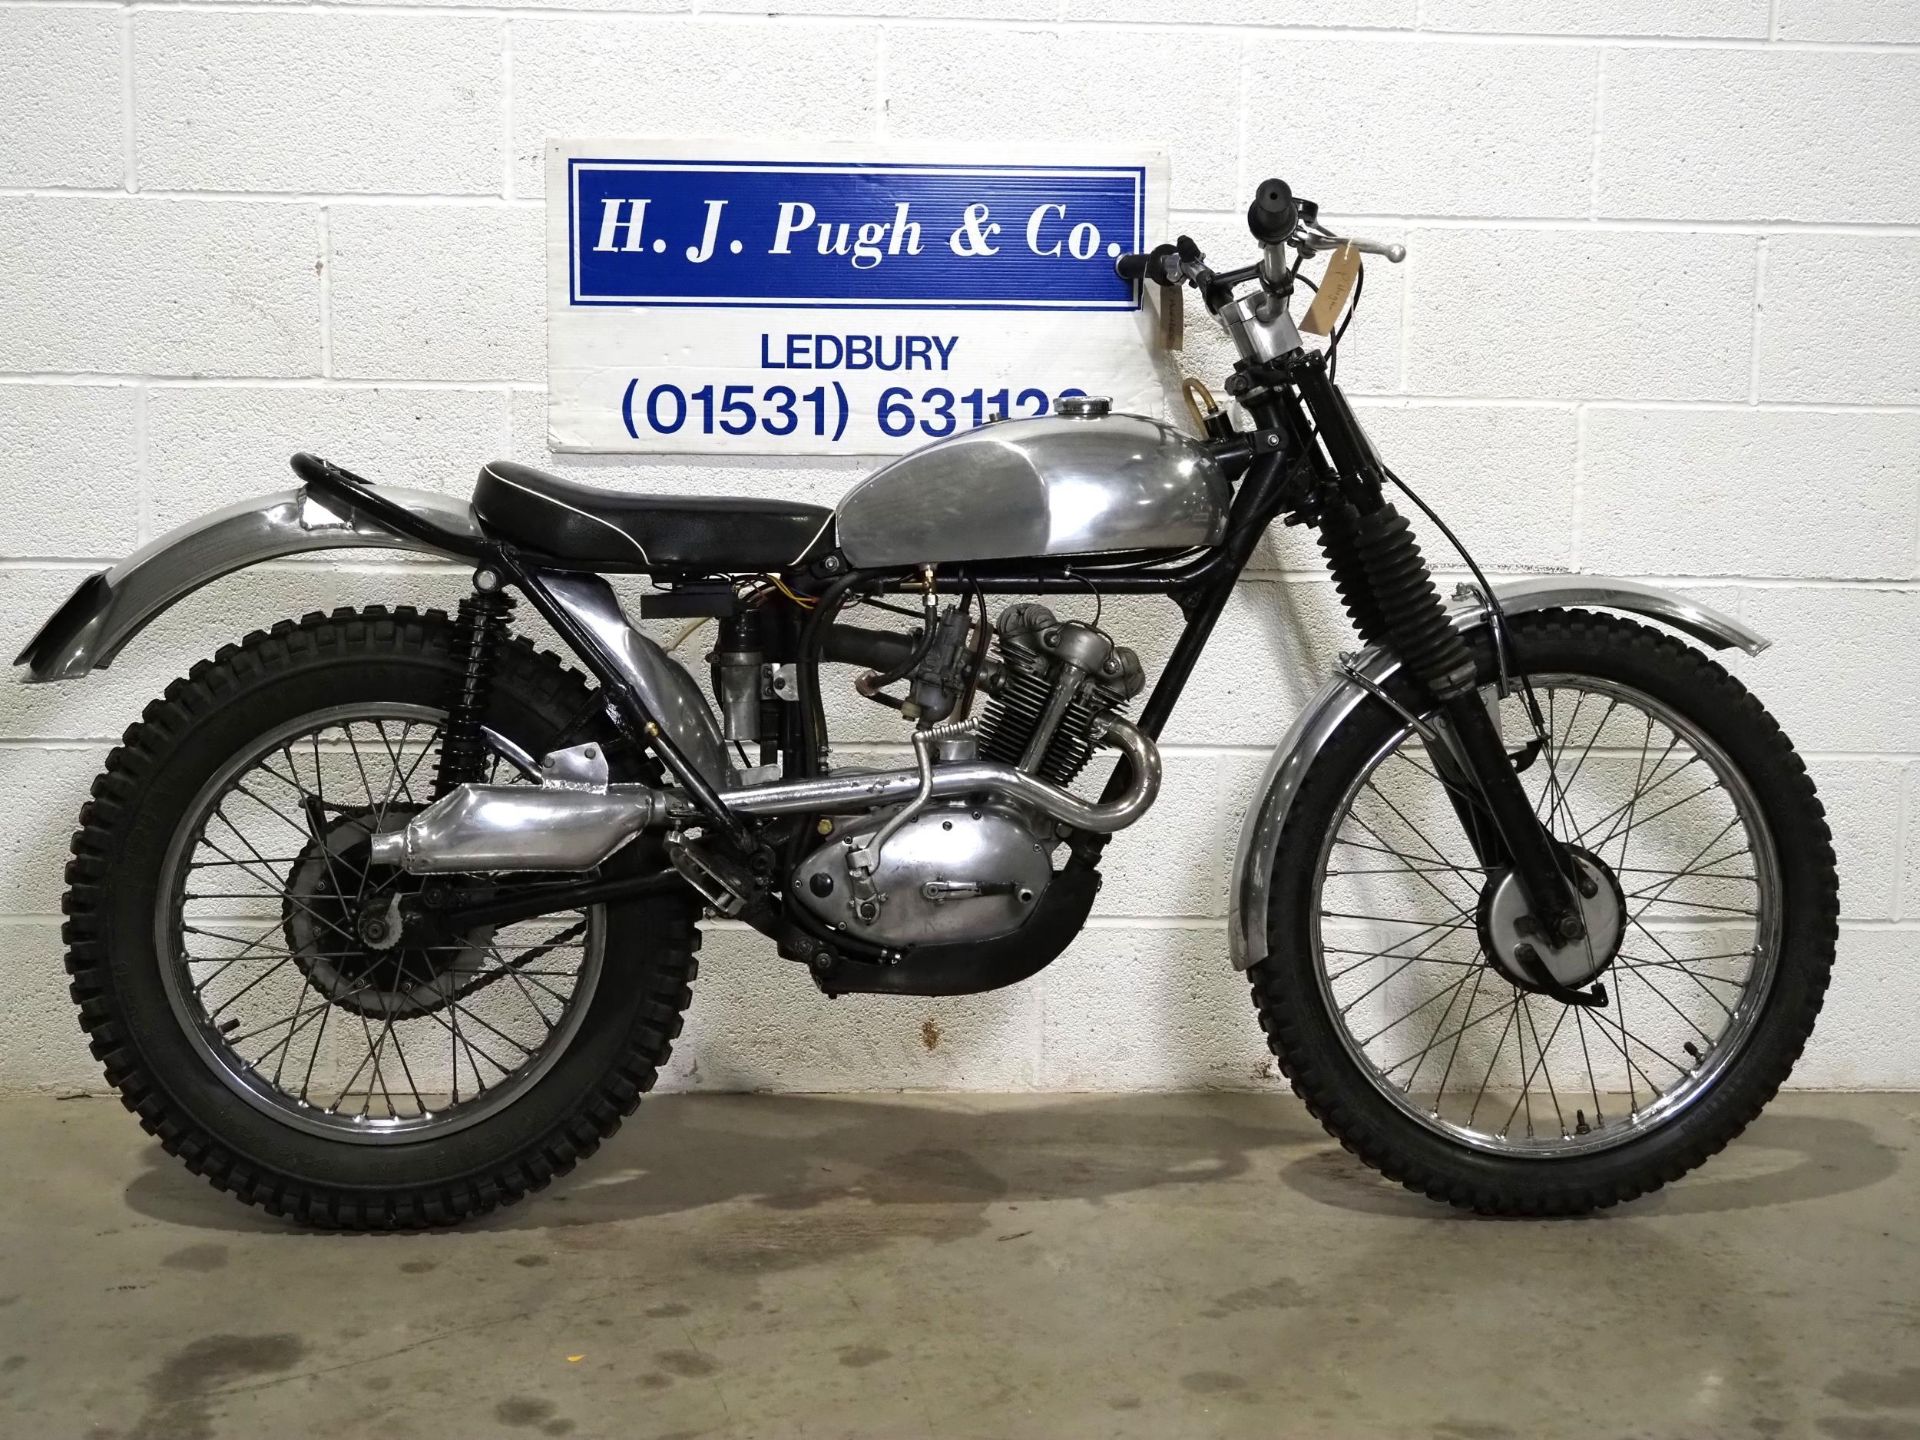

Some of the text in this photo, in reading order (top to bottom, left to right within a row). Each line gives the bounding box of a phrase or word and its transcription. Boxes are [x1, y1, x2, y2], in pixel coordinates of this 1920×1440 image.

[592, 198, 1121, 270] H. J. Pugh & Co.
[761, 334, 959, 371] LEDBURY
[622, 378, 1086, 441] (01531) 63112
